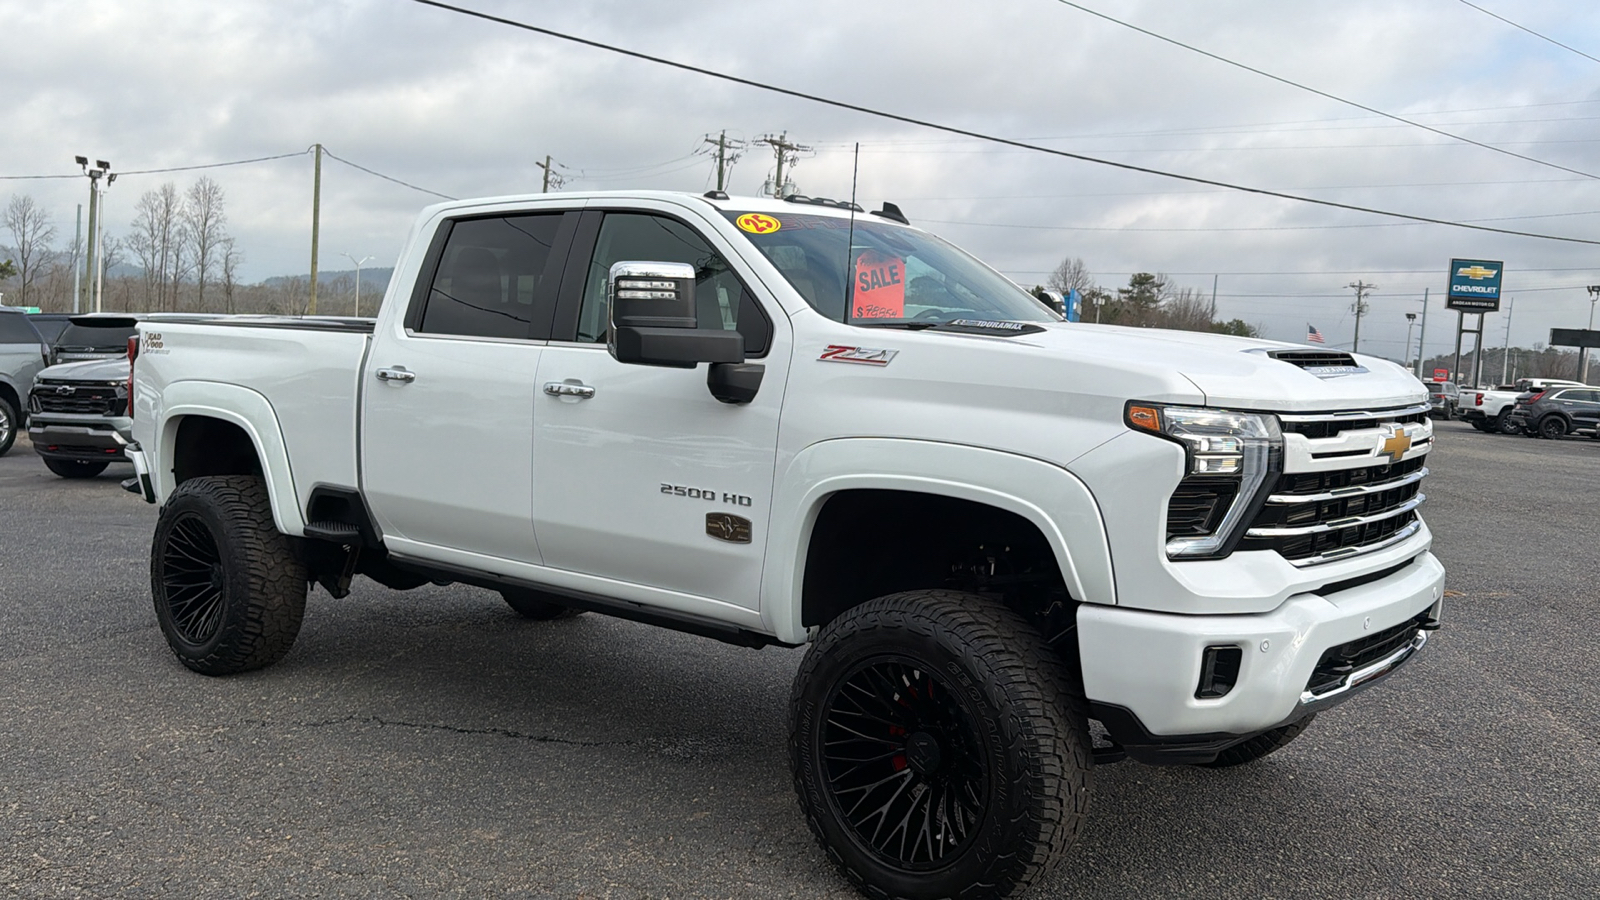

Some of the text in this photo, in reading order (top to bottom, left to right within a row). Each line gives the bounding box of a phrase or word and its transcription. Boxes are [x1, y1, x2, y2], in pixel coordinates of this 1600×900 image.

[744, 214, 773, 232] 25
[859, 265, 900, 292] SALE
[1453, 285, 1497, 293] CHEVROLET
[979, 320, 1024, 330] DURAMAX
[660, 483, 752, 507] 2500 HD
